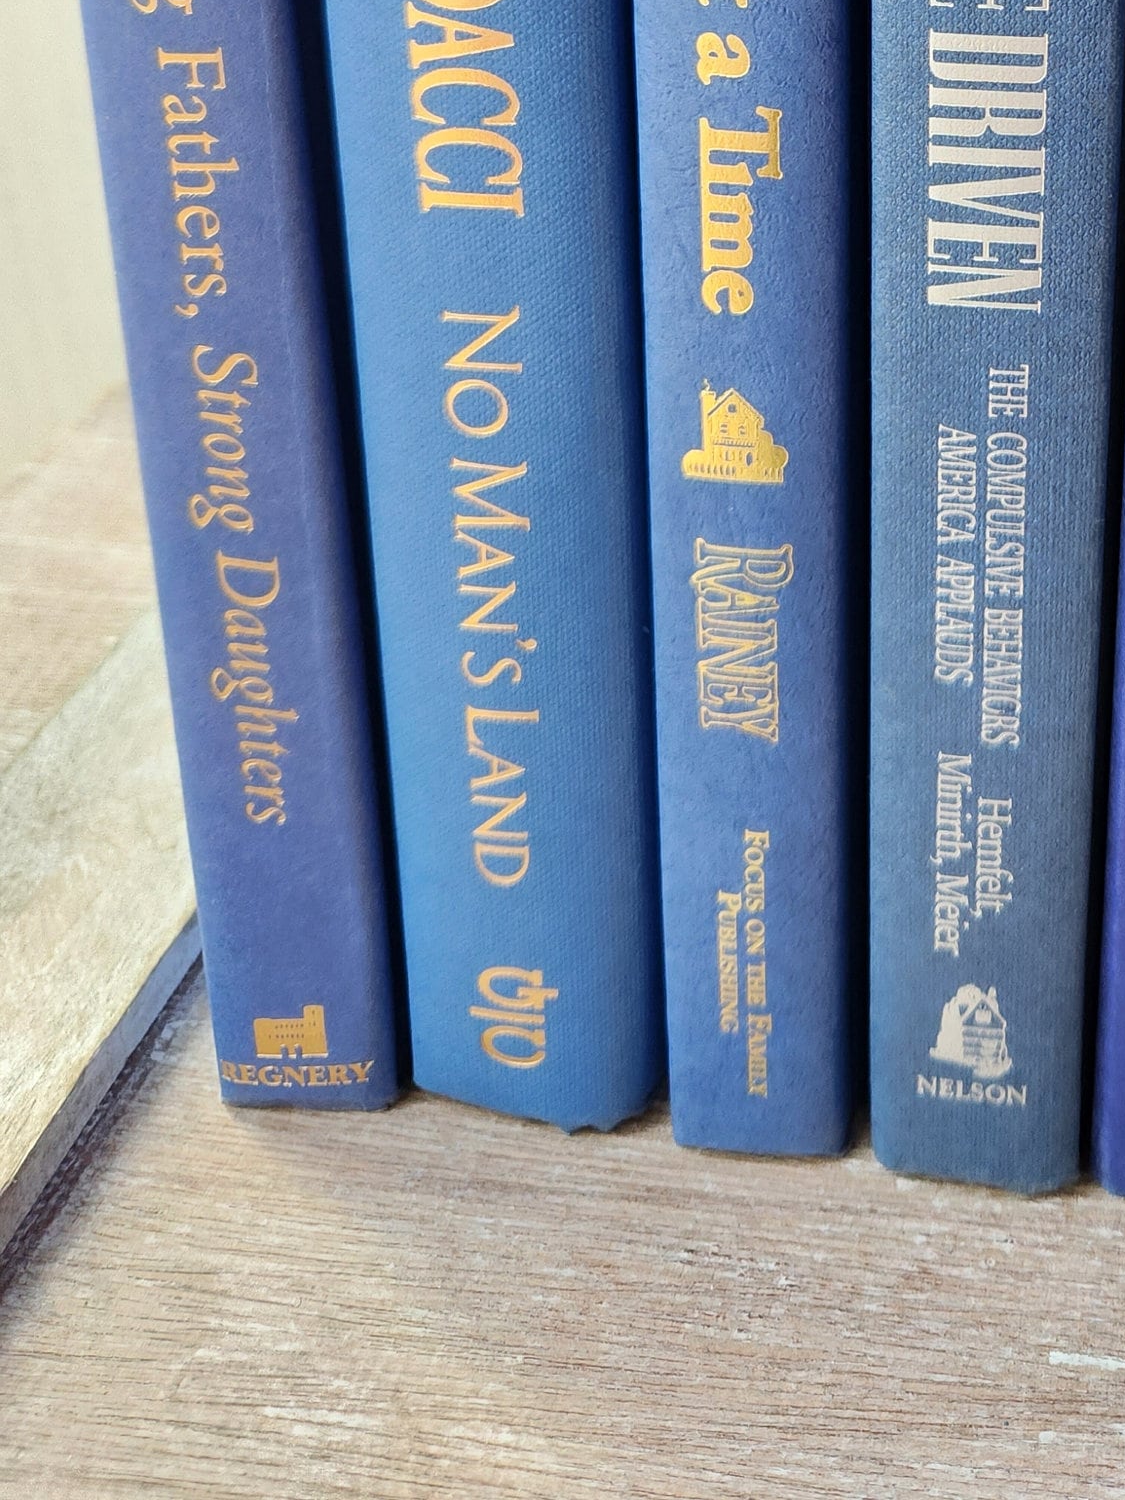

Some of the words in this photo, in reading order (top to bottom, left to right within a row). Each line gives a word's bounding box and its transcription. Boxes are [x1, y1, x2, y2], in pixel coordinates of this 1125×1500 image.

[695, 32, 751, 86] a
[155, 48, 239, 318] Fathers,
[697, 105, 783, 315] Time
[927, 30, 1049, 313] DRIVEN
[440, 306, 523, 438] NO
[988, 365, 1029, 418] THE
[189, 345, 258, 534] Strong
[936, 424, 978, 545] AMERICA
[448, 459, 537, 686] MAN'S
[984, 432, 1028, 595] COMPULSIVE
[690, 537, 794, 744] RAINEY
[934, 555, 975, 686] APPLAUDS
[980, 607, 1023, 746] BEHAVIORS
[210, 551, 299, 826] Daughters
[464, 705, 541, 887] LAND
[930, 751, 973, 865] Minirth,
[970, 797, 1013, 918] Hemfelt,
[743, 829, 770, 912] FOCUS
[746, 918, 765, 954] ON
[932, 872, 969, 957] Meier
[716, 890, 740, 1032] PUBLISHING
[743, 963, 766, 1005] THE
[220, 1059, 374, 1087] REGNERY
[744, 1012, 772, 1098] FAMILY
[917, 1074, 1026, 1105] NELSON
